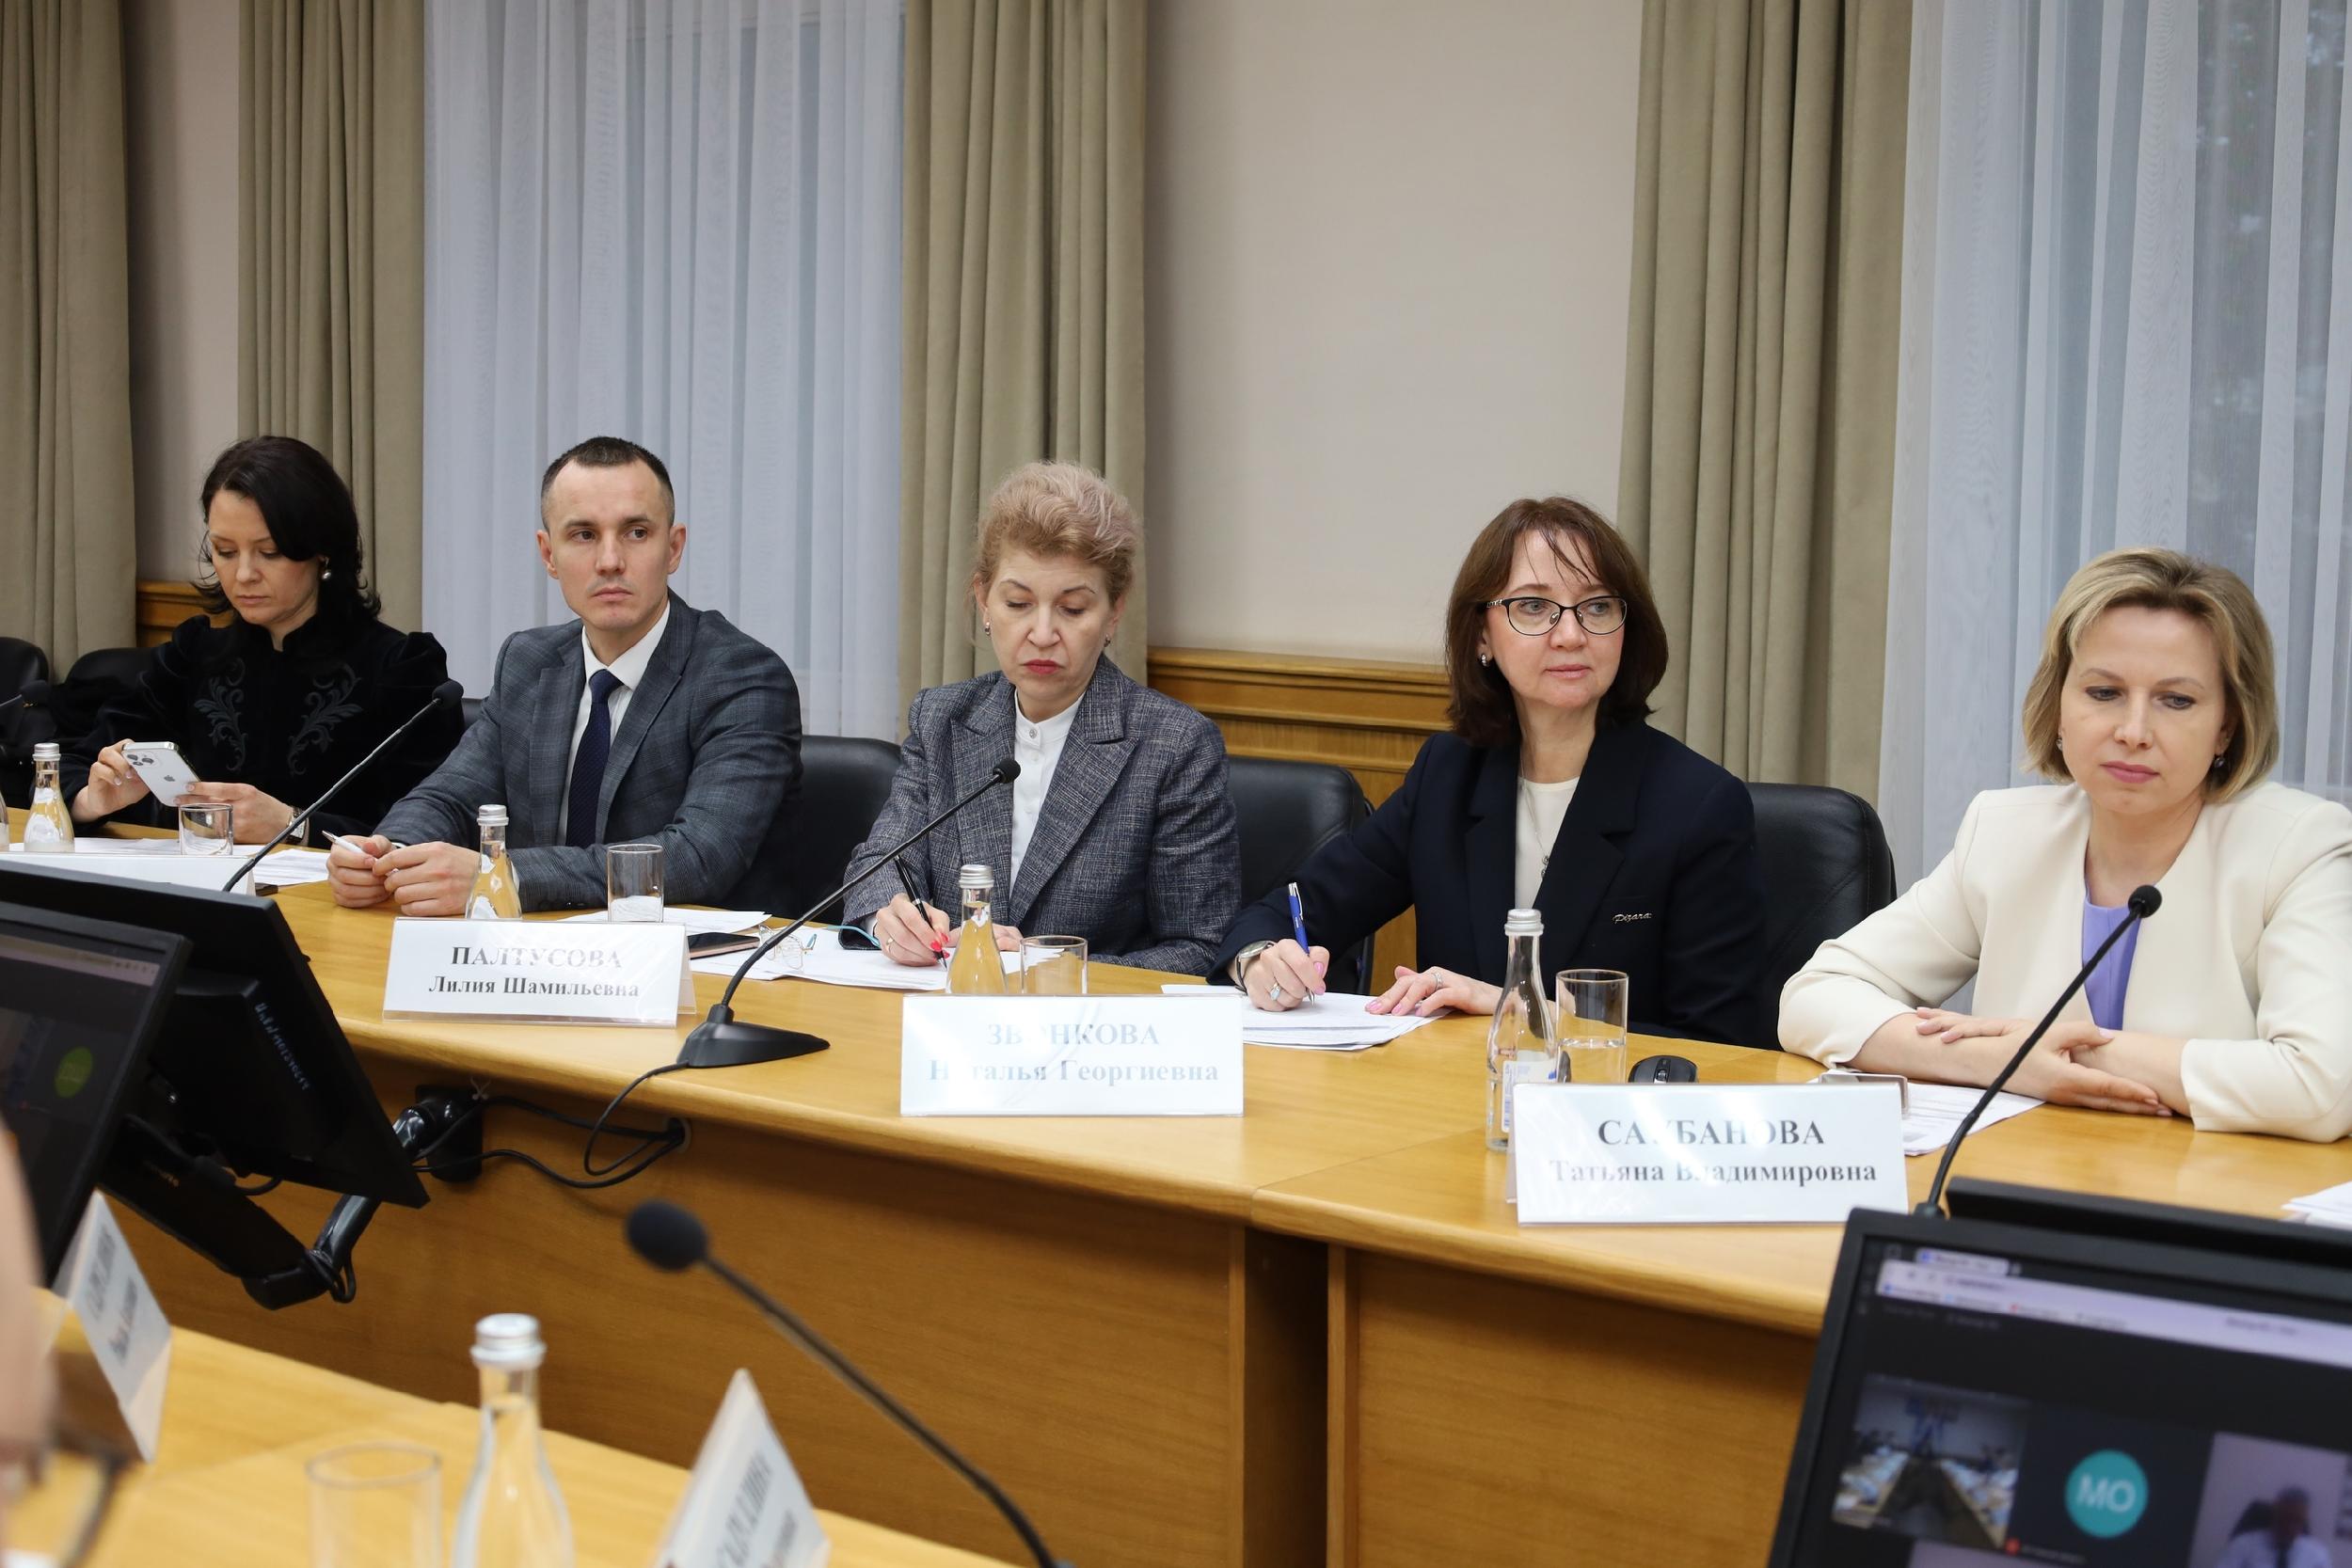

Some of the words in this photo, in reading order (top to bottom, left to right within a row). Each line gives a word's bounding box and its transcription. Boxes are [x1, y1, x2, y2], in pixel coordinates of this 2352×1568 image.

[451, 946, 623, 969] ПАЛТУСОВА
[428, 975, 496, 994] Лилия
[502, 976, 640, 997] Шамильевна
[987, 1023, 1160, 1045] ЗВНКОВА
[929, 1059, 1047, 1082] Нталья
[1060, 1059, 1219, 1086] Георгиевна
[1549, 1160, 1665, 1182] Татьяна
